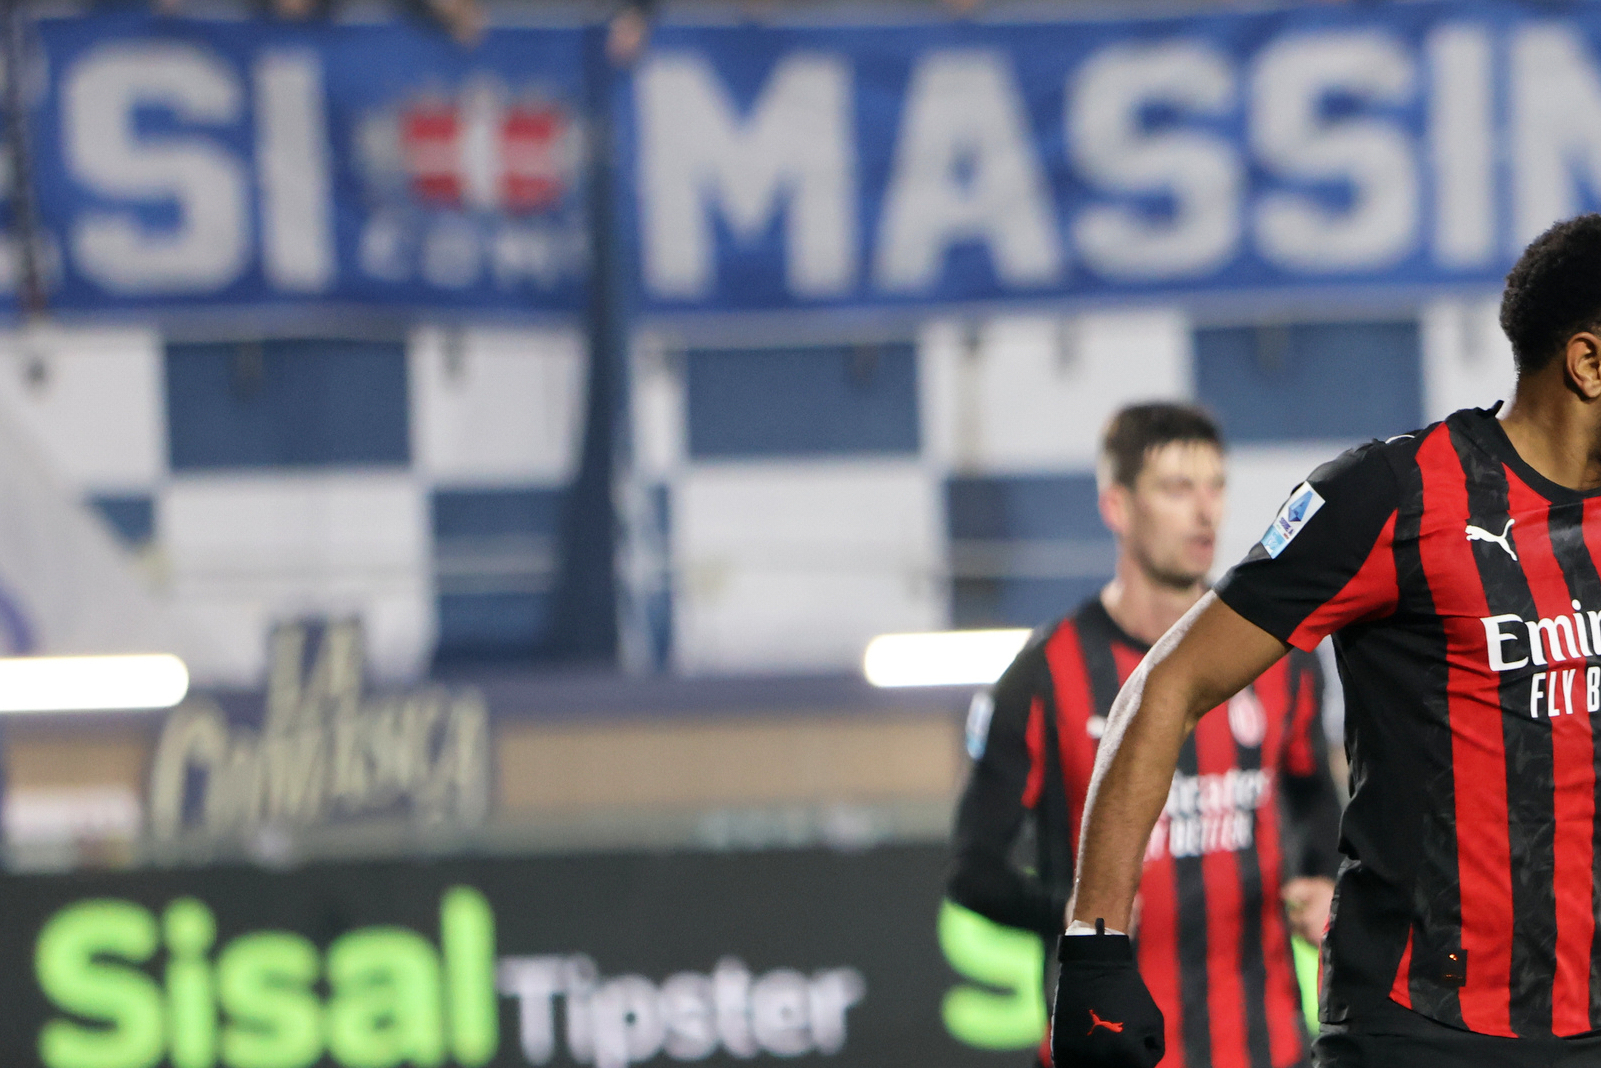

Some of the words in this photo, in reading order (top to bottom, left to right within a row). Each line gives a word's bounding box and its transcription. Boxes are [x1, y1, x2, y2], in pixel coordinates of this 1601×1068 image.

[62, 42, 338, 295] SI
[1530, 668, 1576, 718] FLY
[1168, 809, 1255, 857] BETTER
